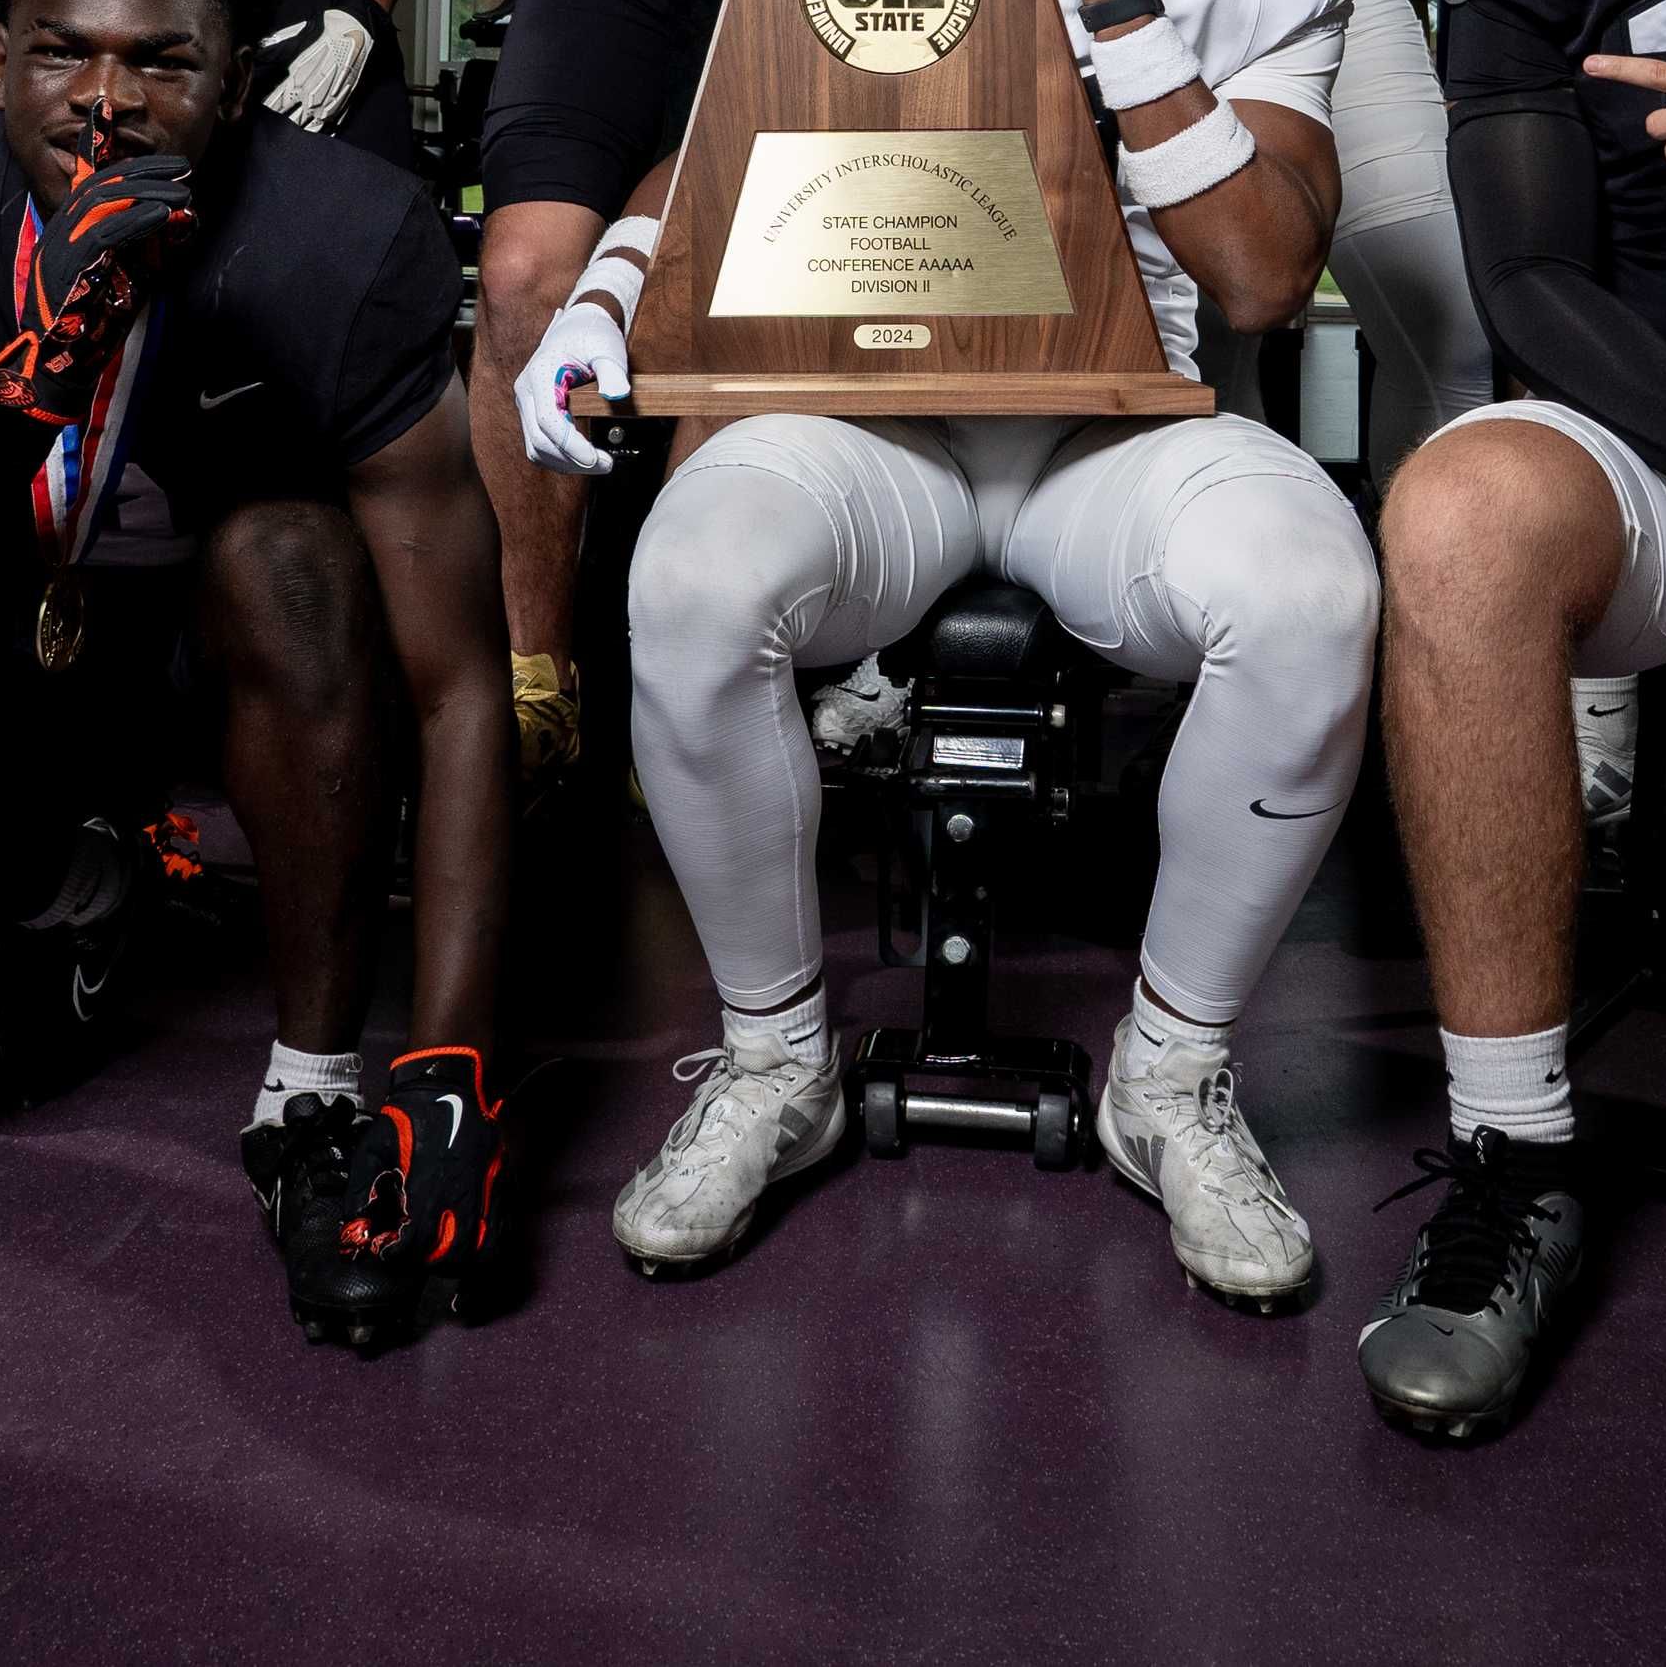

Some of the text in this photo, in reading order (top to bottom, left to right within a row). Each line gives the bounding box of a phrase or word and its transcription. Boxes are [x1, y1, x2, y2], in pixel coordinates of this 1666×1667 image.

[855, 12, 924, 31] STATE
[763, 154, 1017, 245] UNIVERSITY INTERSCHOLASTIC LEAGUE
[822, 215, 958, 229] STATE CHAMPION
[850, 237, 931, 251] FOOTBALL
[807, 258, 974, 272] CONFERENCE AAAAA
[851, 280, 917, 293] DIVISION
[872, 329, 912, 343] 2024
